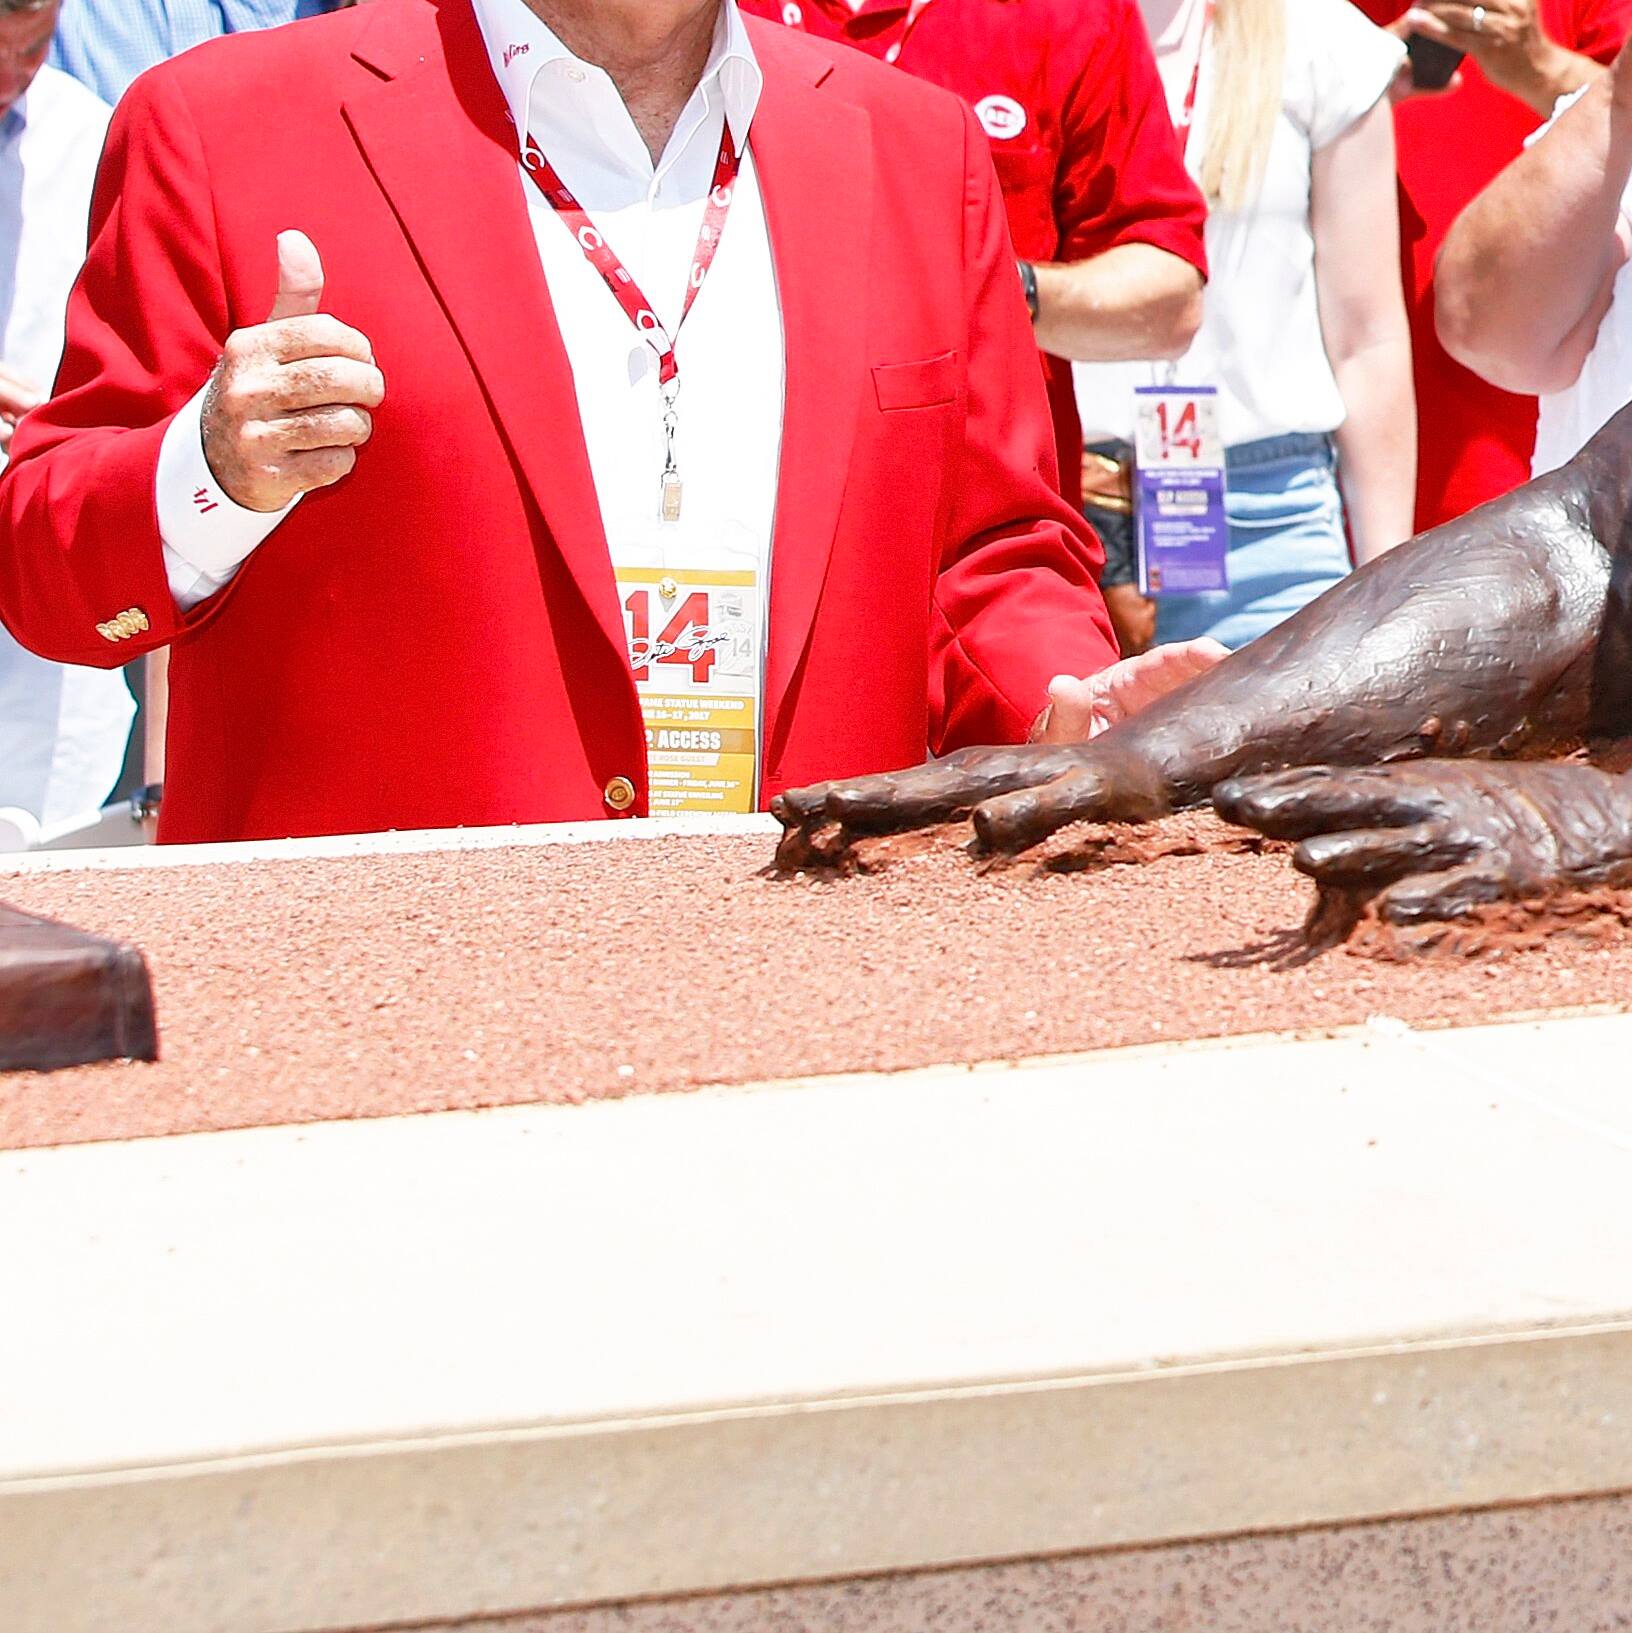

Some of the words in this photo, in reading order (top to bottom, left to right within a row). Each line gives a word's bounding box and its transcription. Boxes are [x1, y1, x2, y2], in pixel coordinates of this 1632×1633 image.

[1156, 401, 1201, 460] 14
[624, 590, 716, 684] 14
[656, 729, 721, 750] ACCESS
